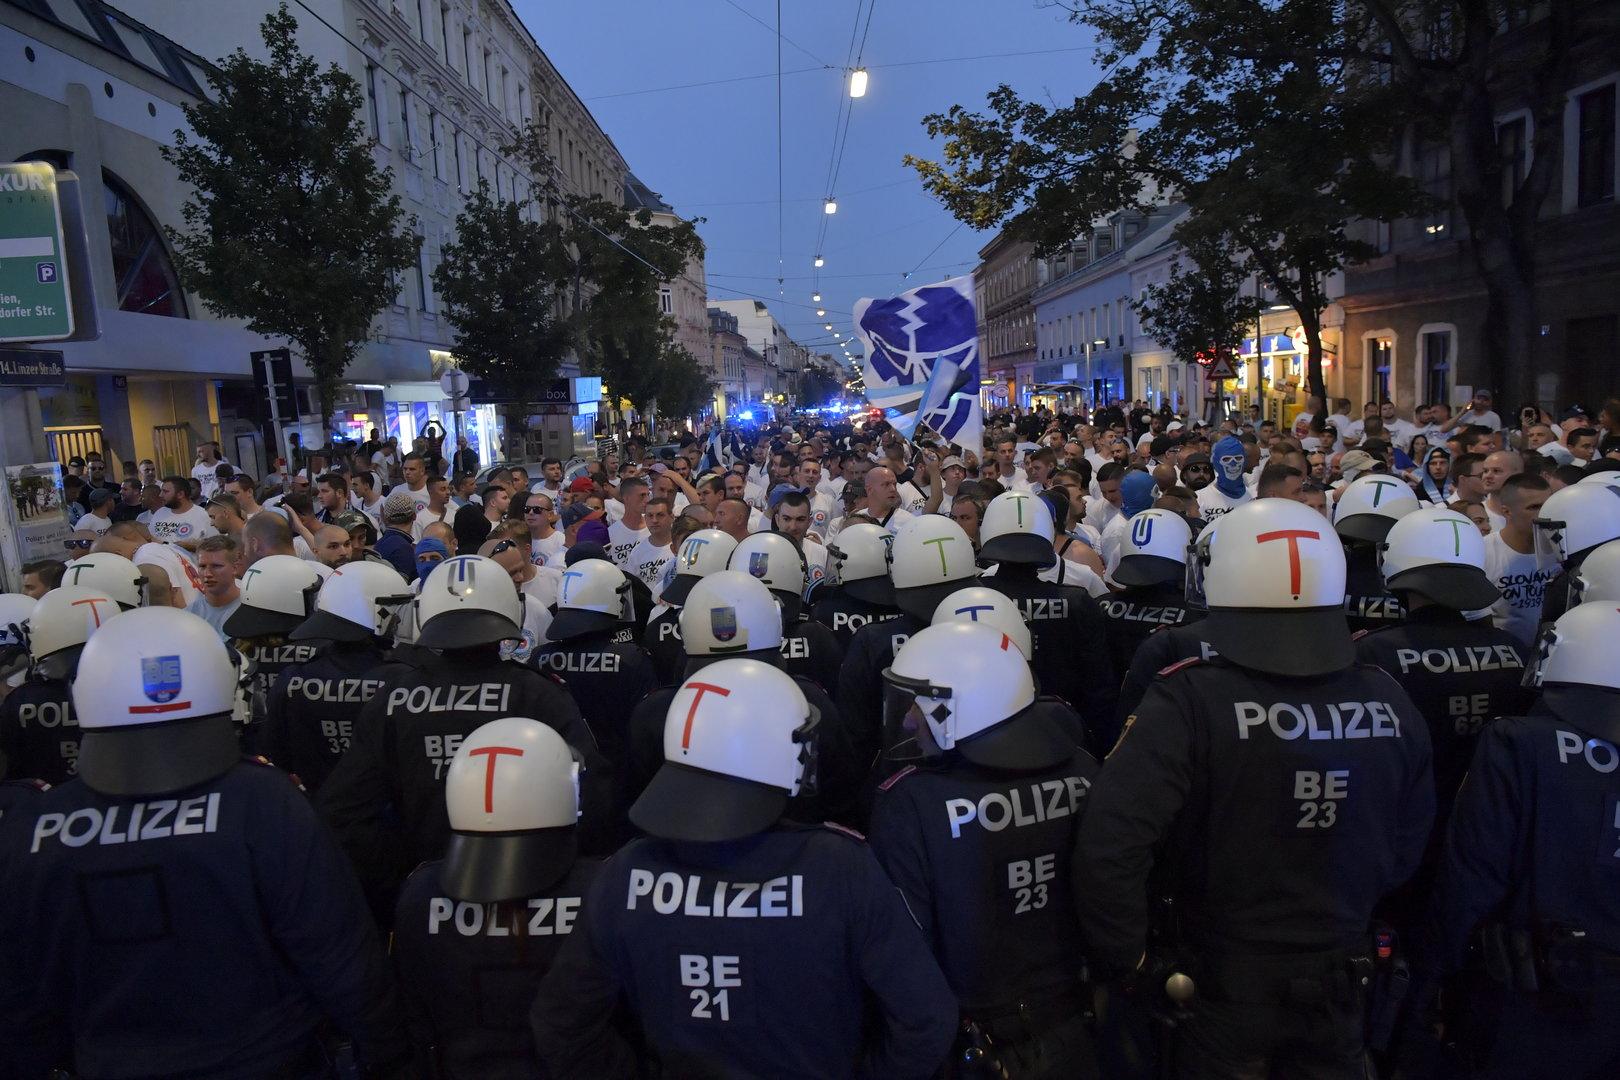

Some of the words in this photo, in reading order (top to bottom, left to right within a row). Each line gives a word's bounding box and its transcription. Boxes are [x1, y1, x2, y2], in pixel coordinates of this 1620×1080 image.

[35, 305, 56, 316] Str.
[13, 361, 39, 375] Linzer
[39, 362, 62, 376] Straße
[546, 388, 567, 400] box
[1498, 569, 1551, 589] SLOVAN
[538, 652, 620, 673] POLIZEI
[1396, 644, 1525, 675] POLIZEI
[386, 683, 511, 716] POLIZEI
[320, 719, 353, 737] BE
[1234, 701, 1402, 741] POLIZEI
[1294, 769, 1350, 800] BE
[30, 792, 221, 854] POLIZEI
[1296, 801, 1337, 829] 23
[1007, 853, 1056, 890] BE
[626, 868, 804, 918] POLIZEI
[1015, 883, 1048, 915] 23
[679, 954, 742, 988] BE
[689, 989, 730, 1021] 21
